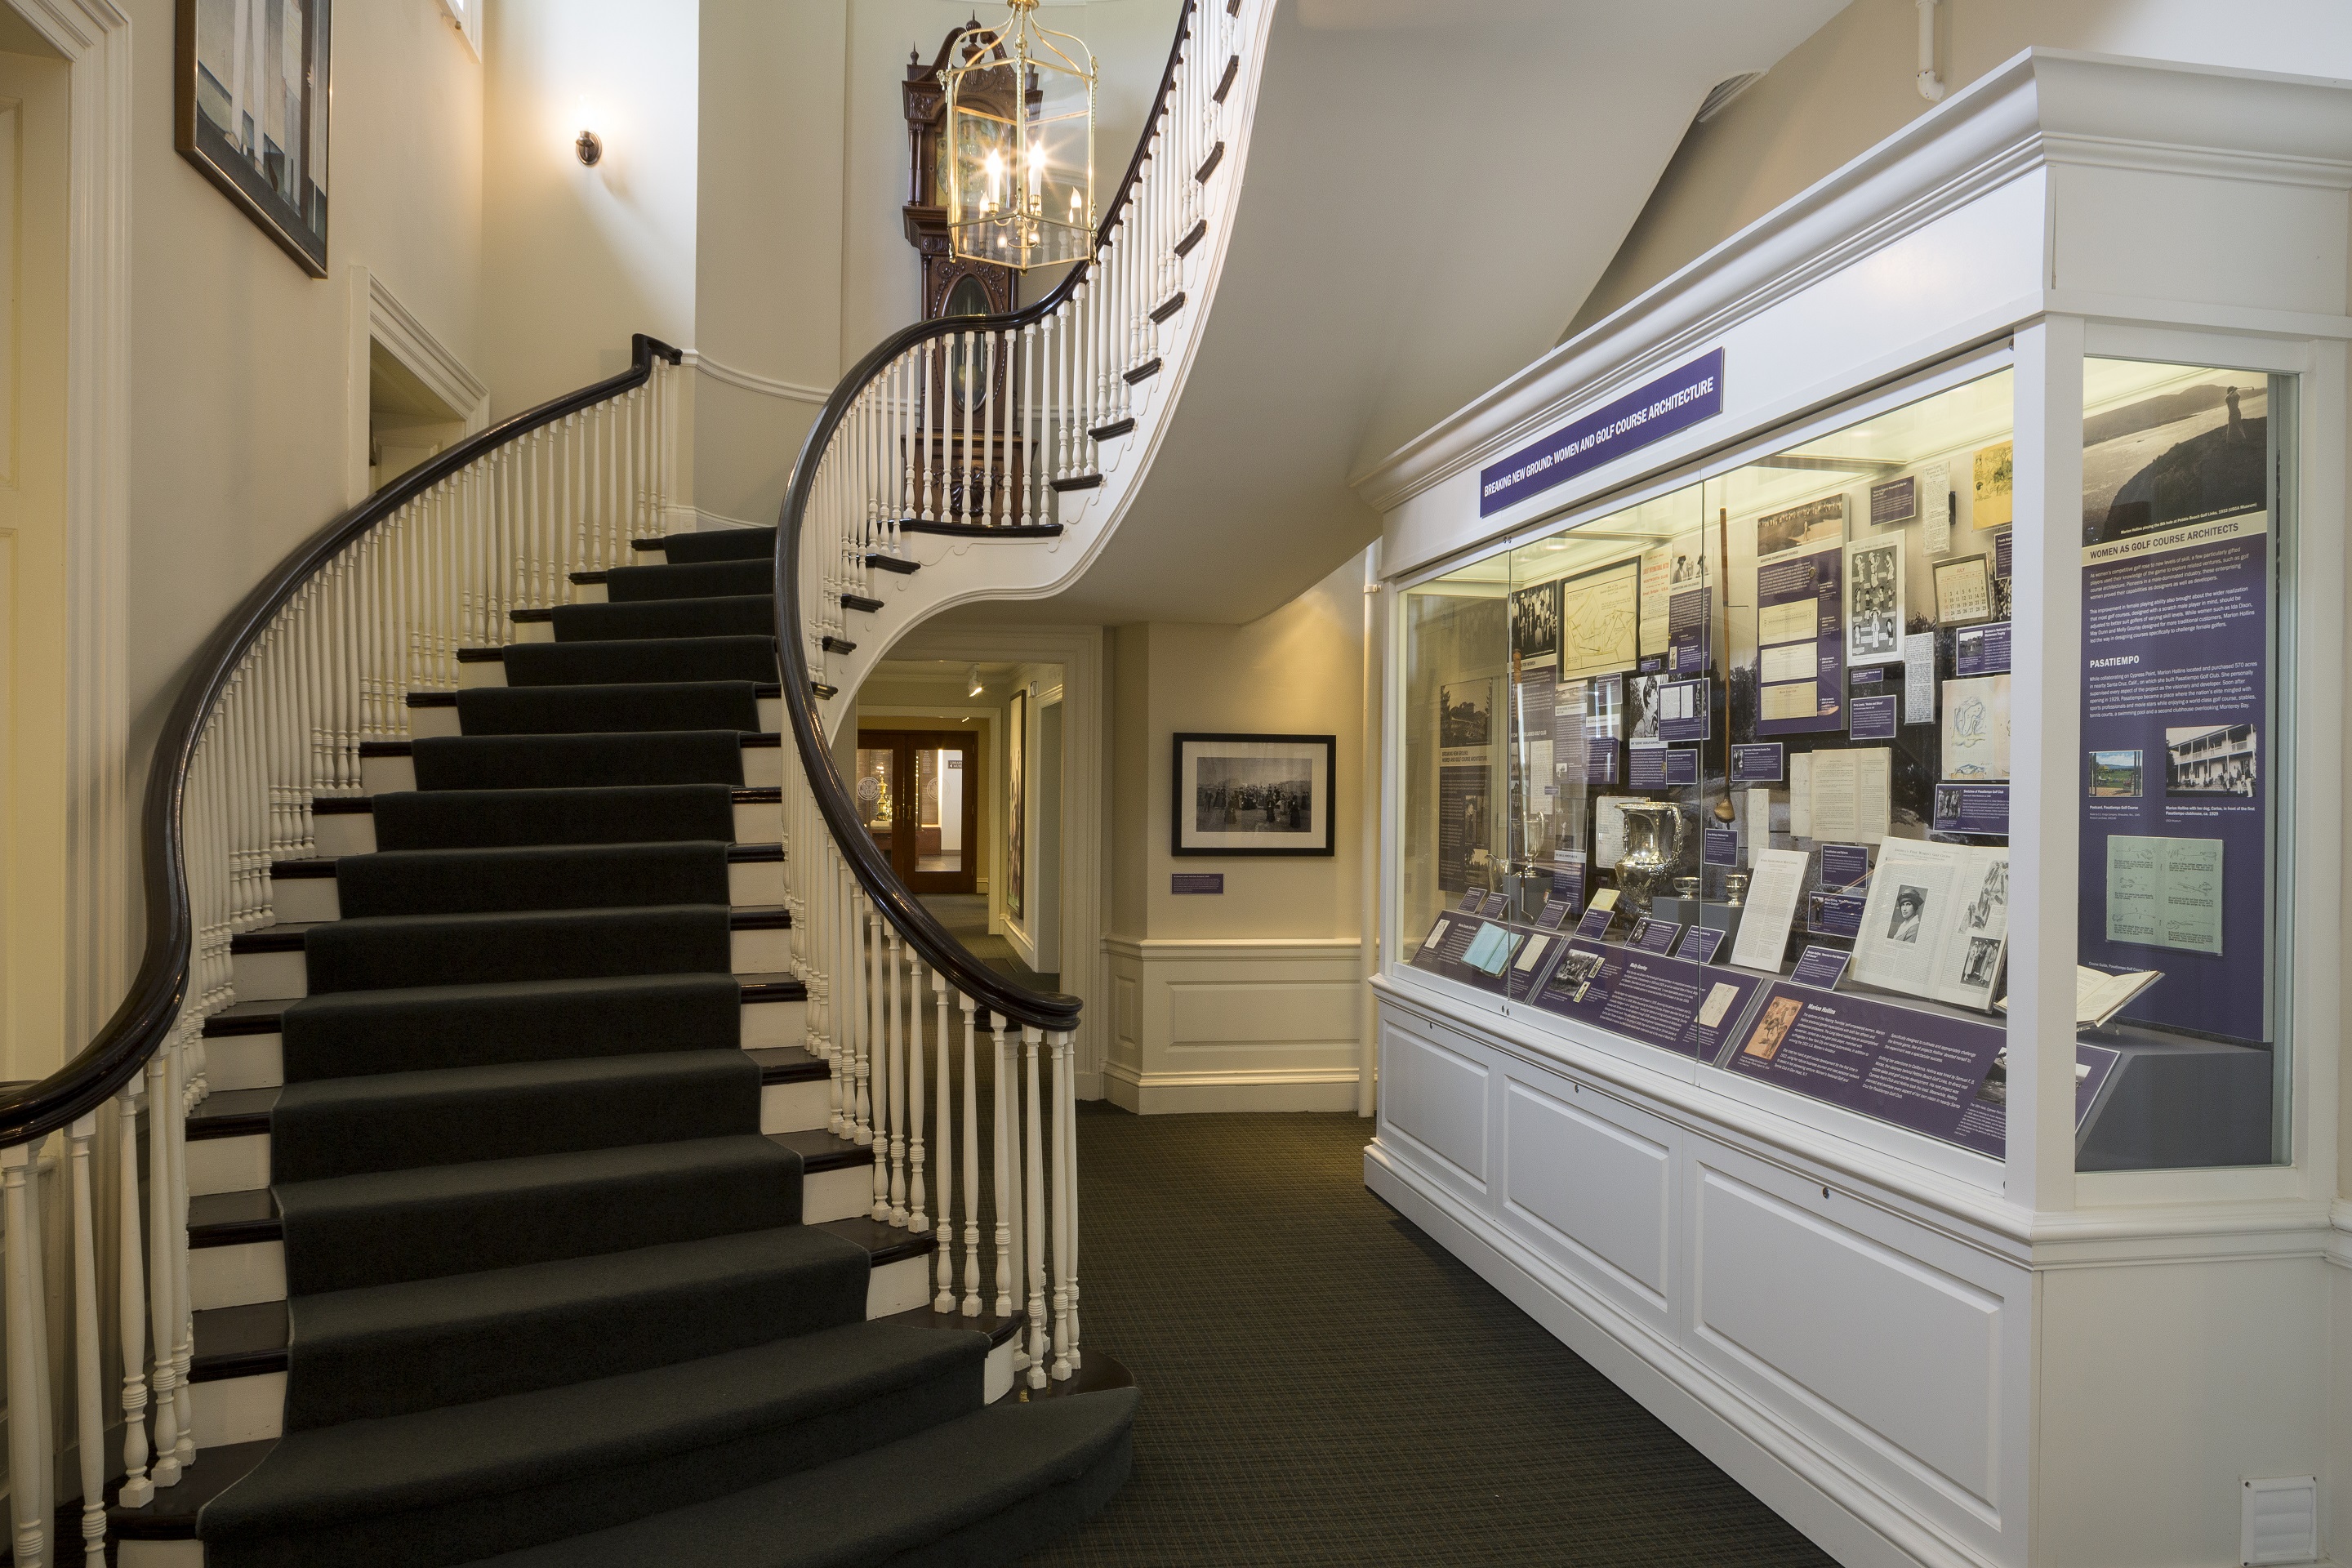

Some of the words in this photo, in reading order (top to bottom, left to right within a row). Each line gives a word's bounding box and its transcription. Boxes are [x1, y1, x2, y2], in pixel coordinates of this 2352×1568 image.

[1485, 473, 1511, 497] BREAKING
[1512, 466, 1525, 483] NEW
[1526, 453, 1552, 477] GROUND:
[1554, 440, 1579, 465] WOMEN
[1580, 433, 1594, 452] AND
[1596, 423, 1614, 445] GOLF
[1615, 408, 1646, 436] COURSE
[1648, 376, 1713, 421] ARCHITECTURE
[2090, 546, 2118, 559] WOMEN
[2119, 543, 2129, 553] AS
[2132, 539, 2150, 551] GOLF
[2153, 532, 2185, 547] COURSE
[2187, 522, 2238, 541] ARCHITECTS
[2090, 655, 2139, 668] PASATIEMPO
[2176, 674, 2199, 682] Pasatiempo
[2230, 669, 2253, 677] personally
[1807, 1003, 1822, 1011] Marion
[1821, 1006, 1836, 1014] Hollins
